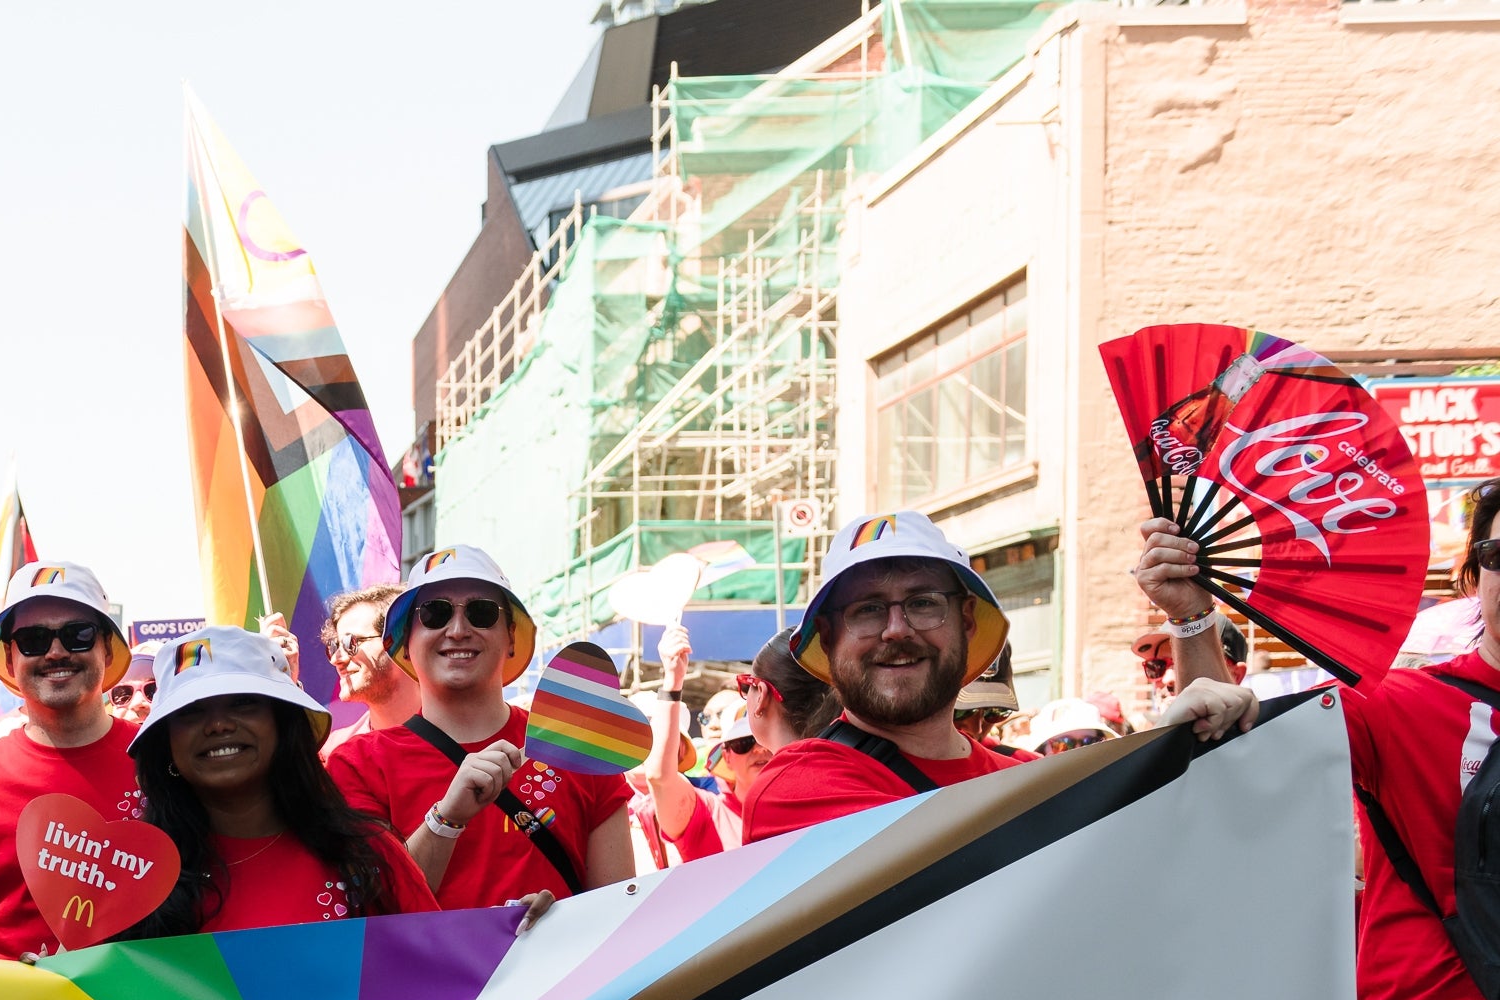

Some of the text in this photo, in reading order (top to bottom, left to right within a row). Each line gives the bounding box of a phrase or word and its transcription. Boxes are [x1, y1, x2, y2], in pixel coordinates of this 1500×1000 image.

[1401, 387, 1479, 423] JACK
[1398, 421, 1500, 458] STOR'S
[1337, 440, 1405, 495] celebrate
[140, 622, 176, 636] GOD'S
[44, 821, 154, 880] livin' my
